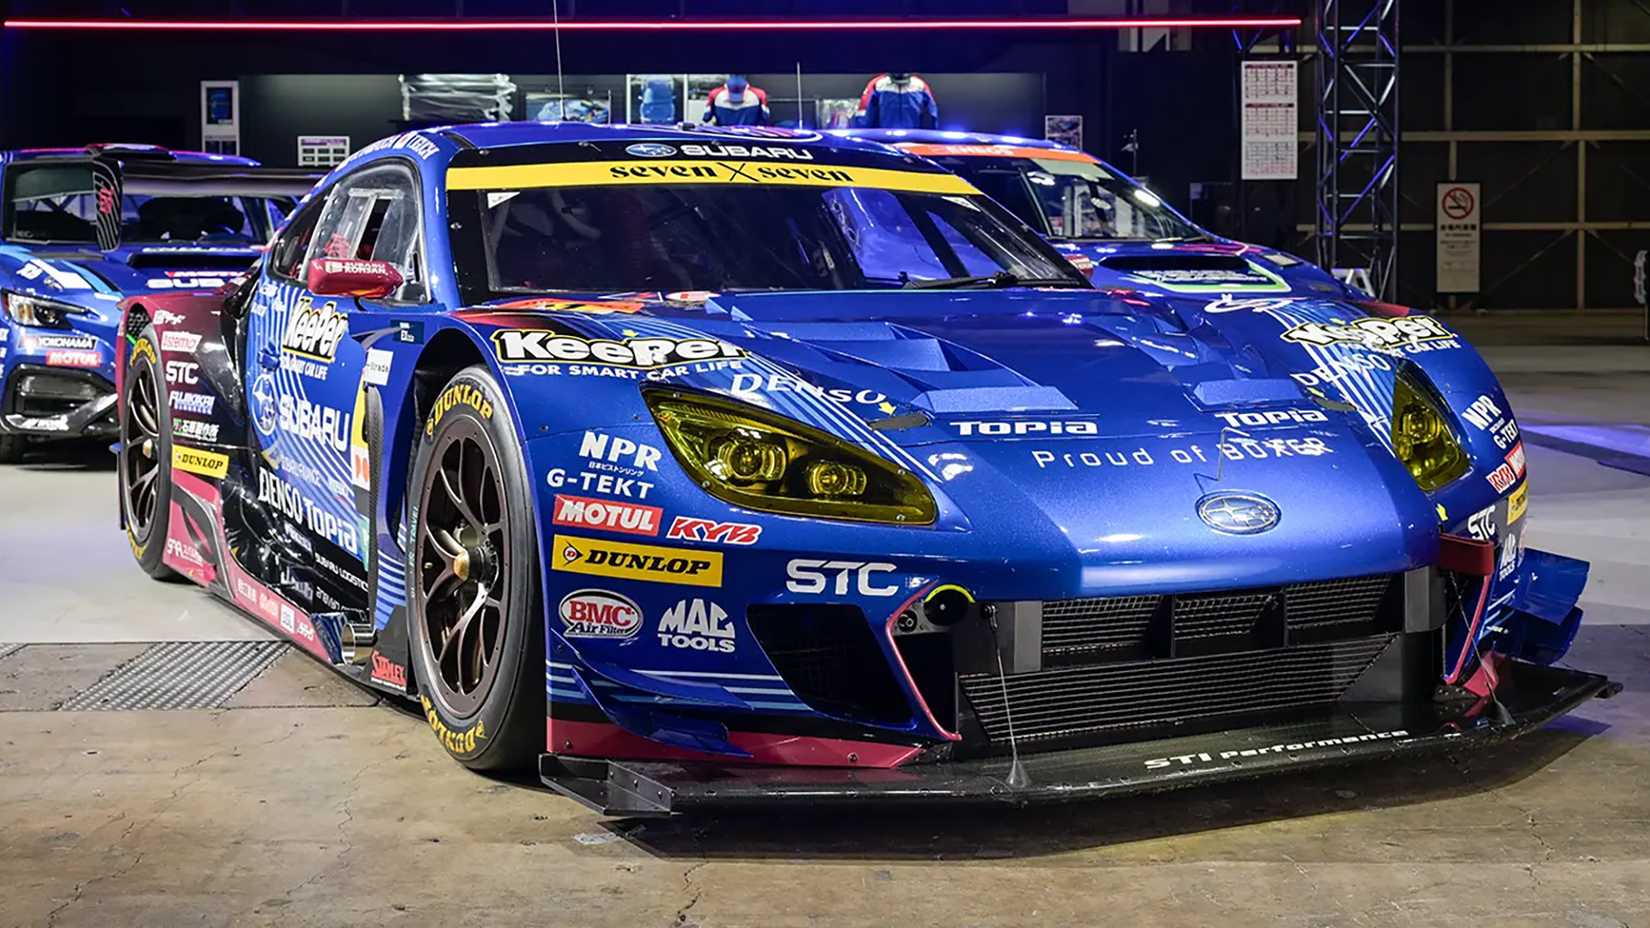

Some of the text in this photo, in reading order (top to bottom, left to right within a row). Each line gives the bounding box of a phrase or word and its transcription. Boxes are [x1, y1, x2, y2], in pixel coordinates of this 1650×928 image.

[680, 144, 813, 160] SUBARU
[609, 163, 717, 178] seven
[757, 166, 854, 182] seven
[39, 336, 95, 349] YOKOHAMA
[284, 297, 348, 360] KeePer
[497, 330, 746, 367] KeePer
[166, 360, 199, 385] STC
[516, 360, 743, 381] FOR SMART CAR LIFE
[730, 373, 886, 405] DENSO
[434, 383, 493, 427] DUNLOP
[1462, 394, 1502, 431] NPR
[280, 393, 350, 452] SUBARU
[181, 453, 223, 470] DUNLOP
[579, 431, 662, 472] NPR
[1032, 447, 1155, 469] Proud
[1170, 444, 1207, 464] of
[259, 466, 304, 525] DENSO
[546, 468, 654, 499] G-TEKT
[558, 499, 654, 531] MOTUL
[667, 517, 761, 544] KYB
[585, 549, 711, 575] DUNLOP
[786, 559, 899, 597] STC
[569, 600, 631, 627] BMC
[569, 622, 625, 634] Air Filter
[658, 598, 736, 638] MAC
[658, 633, 736, 654] TOOLS
[1144, 730, 1409, 770] STI Performance
